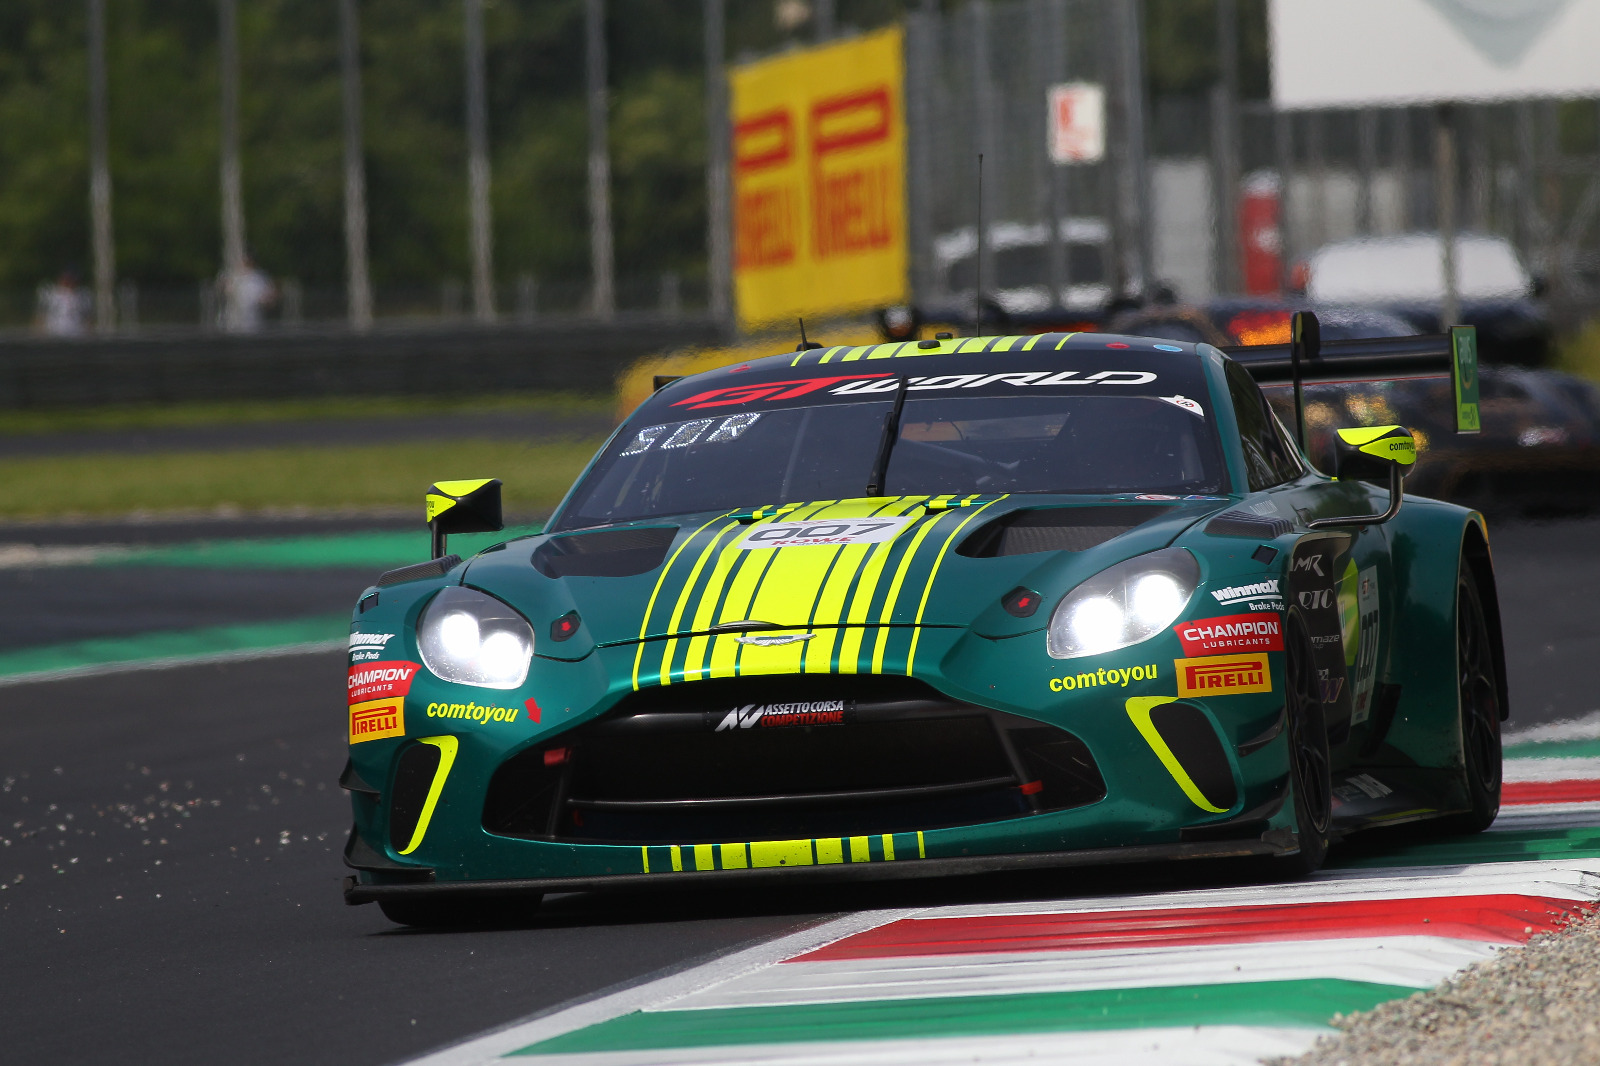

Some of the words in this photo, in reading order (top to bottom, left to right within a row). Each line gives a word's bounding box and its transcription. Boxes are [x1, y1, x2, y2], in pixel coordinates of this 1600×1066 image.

[668, 372, 895, 411] GT
[828, 370, 1157, 396] WORLD
[748, 522, 896, 541] 007
[771, 536, 856, 546] ROWE
[1248, 601, 1271, 611] Brake
[1271, 601, 1285, 611] Pads
[1183, 621, 1279, 641] CHAMPION
[1202, 638, 1271, 649] LUBRICANTS
[348, 668, 411, 689] CHAMPION
[1049, 664, 1158, 692] comtoyou
[1186, 661, 1263, 690] PIRELLI
[351, 683, 394, 698] LUBRICANTS
[426, 702, 519, 725] comtoyou
[764, 702, 810, 716] ASSETTO
[810, 700, 844, 713] CORSA
[352, 705, 398, 736] PIRELLI
[761, 711, 844, 728] COMPETIZIONE
